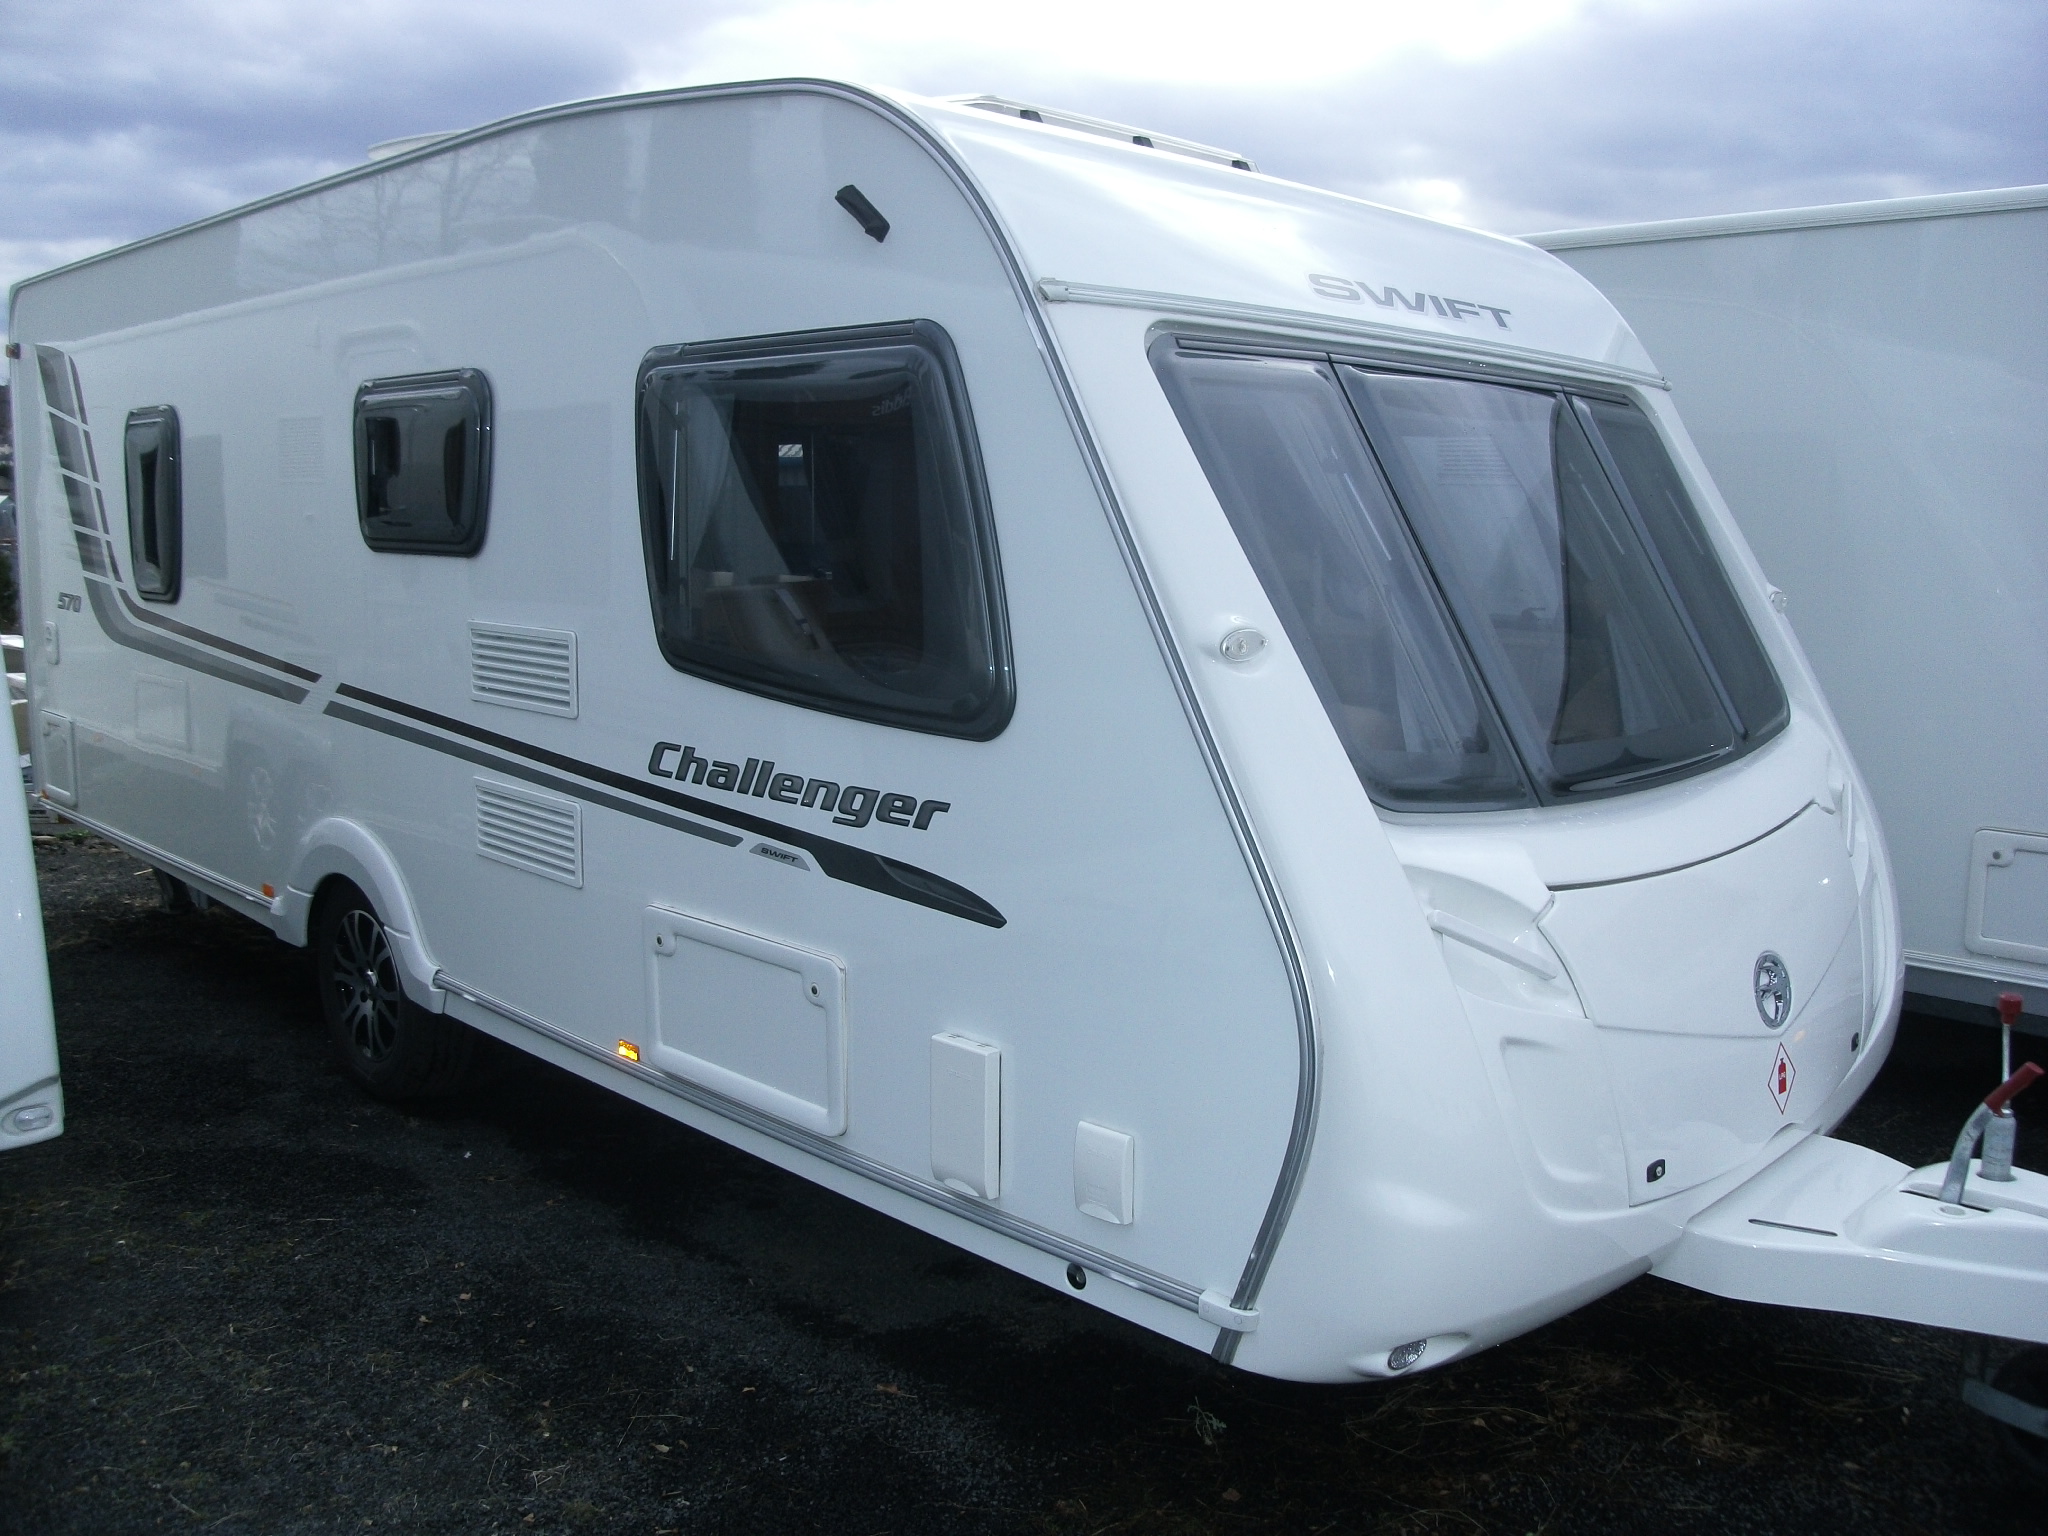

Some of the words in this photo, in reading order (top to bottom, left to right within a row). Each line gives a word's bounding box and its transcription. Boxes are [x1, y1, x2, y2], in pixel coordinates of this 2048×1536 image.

[1307, 272, 1512, 330] SWIFT
[57, 591, 82, 613] 570
[647, 740, 951, 831] Challenger
[760, 847, 799, 863] SWIFT
